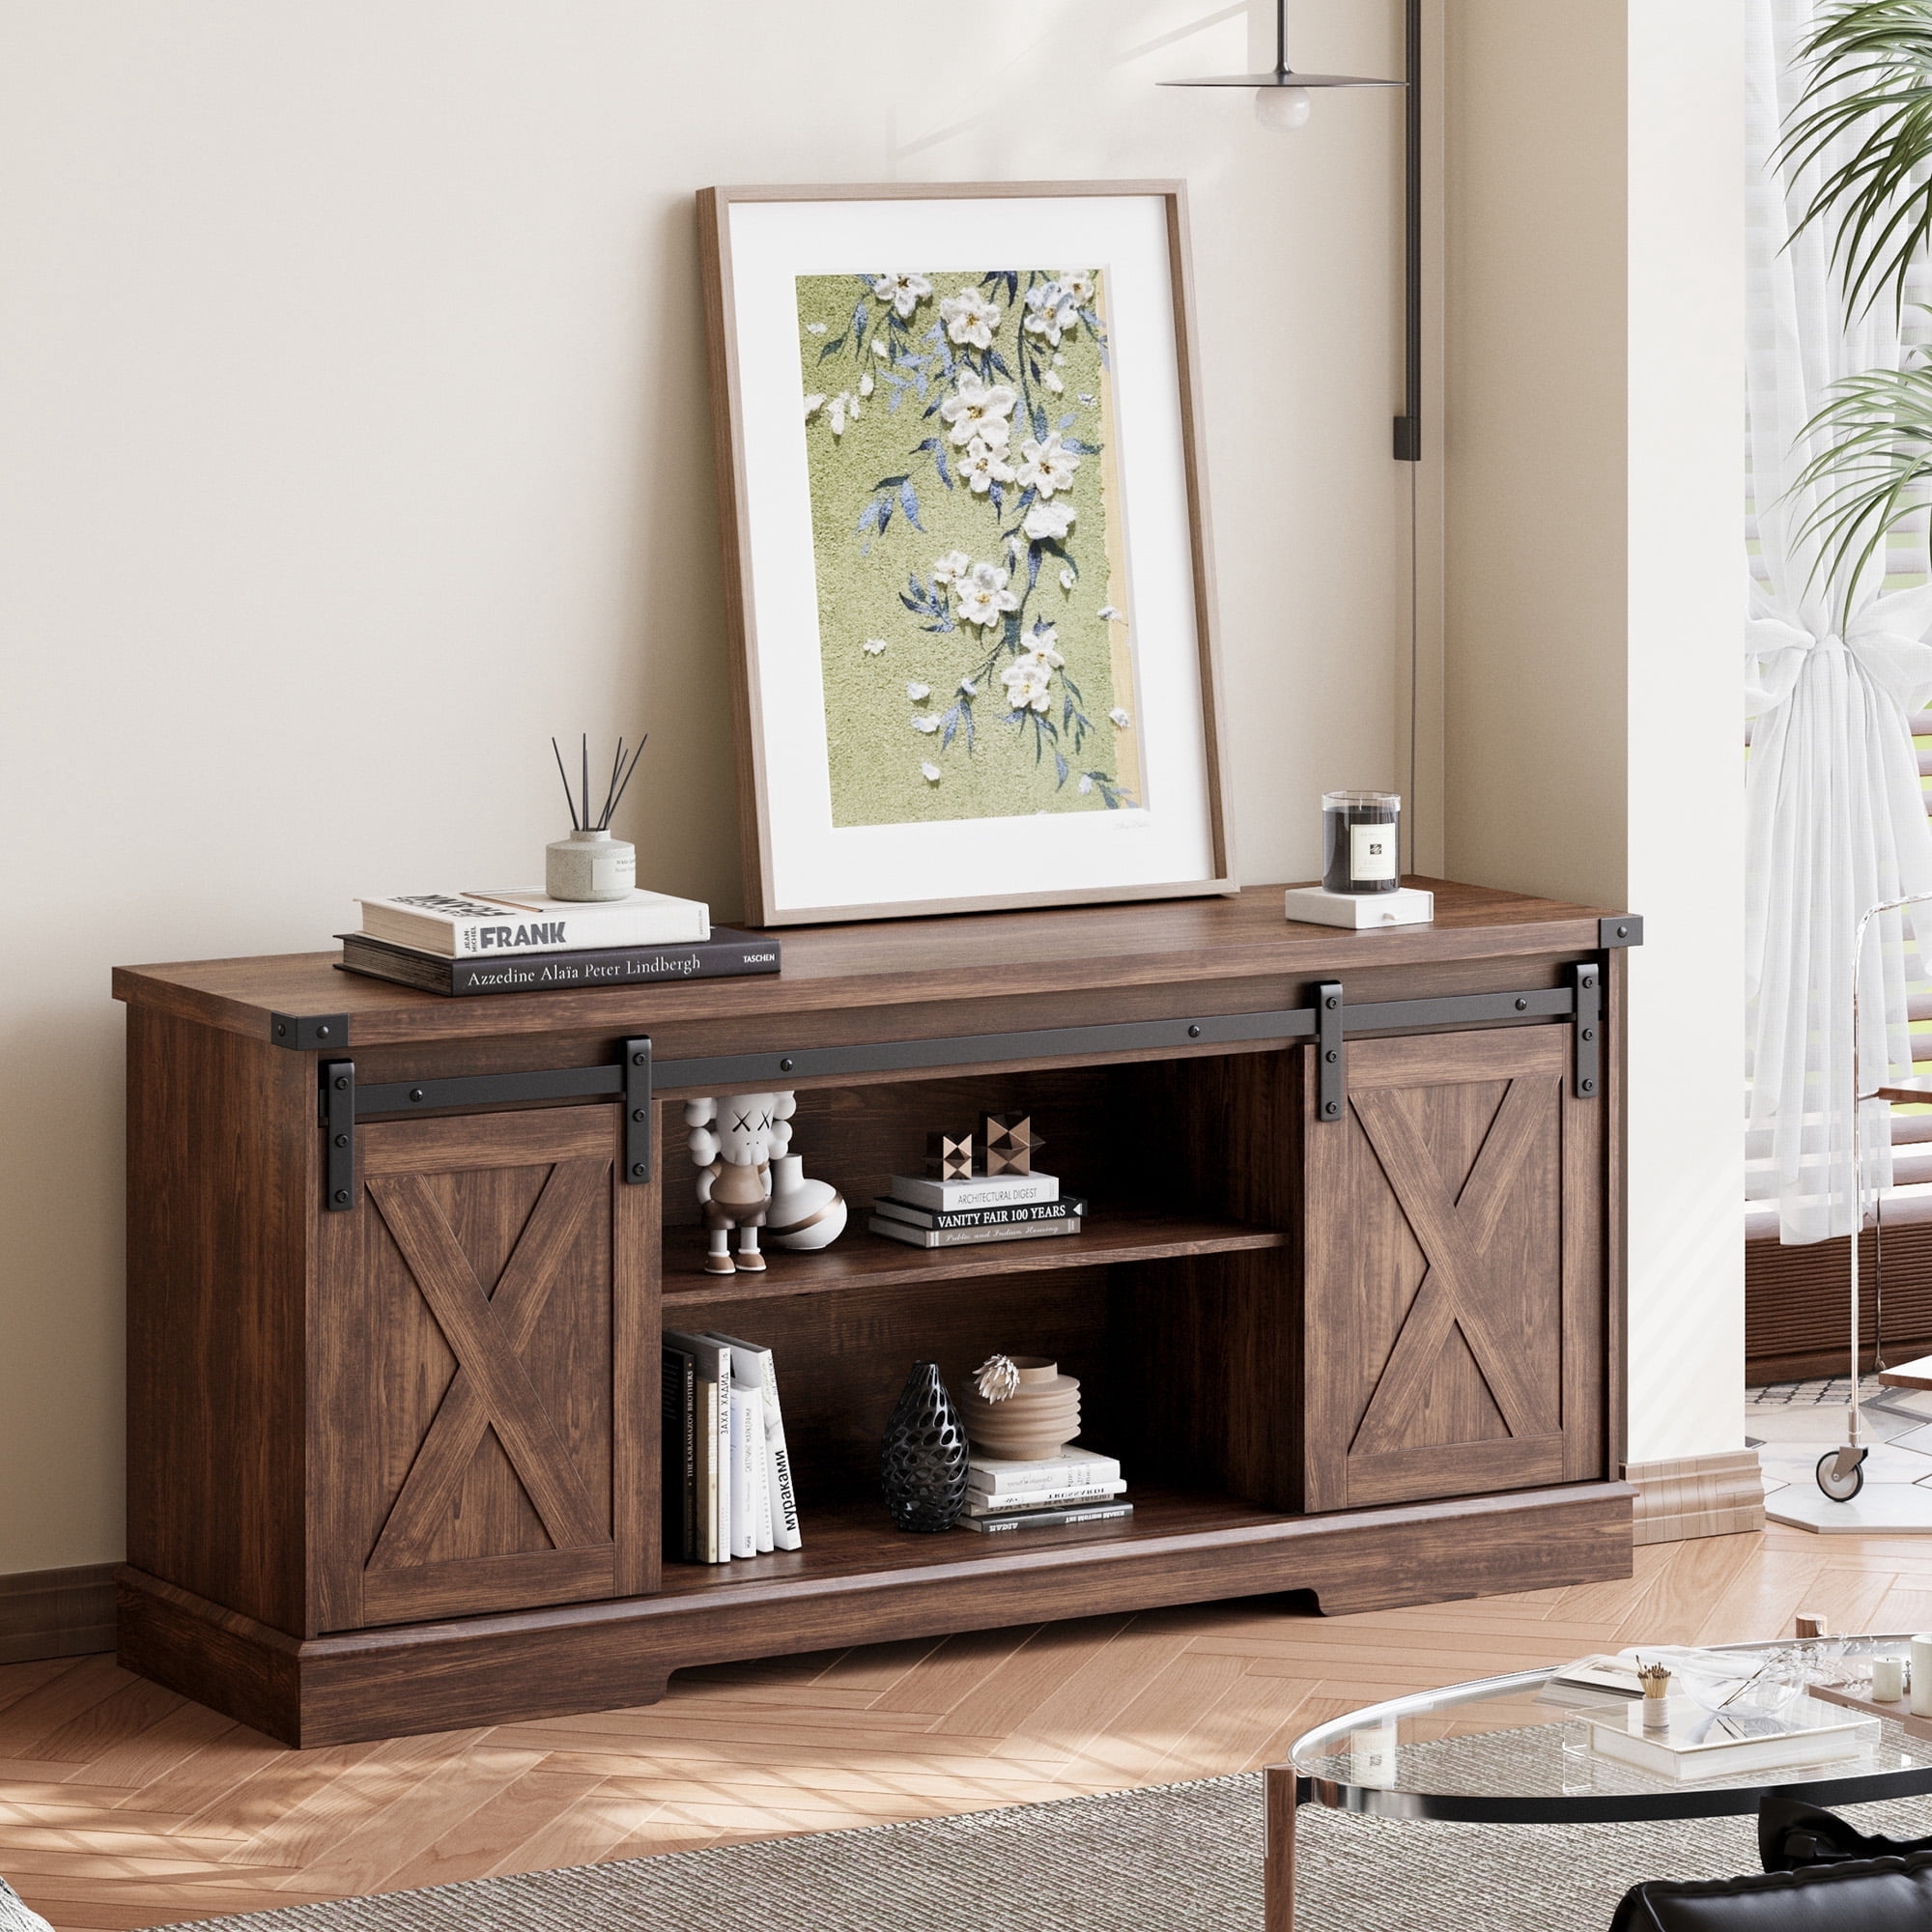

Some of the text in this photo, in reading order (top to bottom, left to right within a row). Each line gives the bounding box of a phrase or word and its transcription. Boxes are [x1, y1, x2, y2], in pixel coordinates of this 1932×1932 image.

[480, 922, 566, 949] FRANK
[468, 953, 701, 986] Azzedine Alaïa Peter Lindbergh
[743, 952, 776, 964] TASCHEN
[957, 1190, 1011, 1206] ARCHITECTURAL
[1012, 1187, 1037, 1200] DIGEST
[937, 1205, 1066, 1229] VANITY FAIR 100 YEARS
[945, 1233, 971, 1243] Public
[974, 1230, 990, 1239] and
[992, 1228, 1022, 1237] Indian
[720, 1372, 730, 1406] ХАДИД
[720, 1410, 729, 1435] ЗАХА
